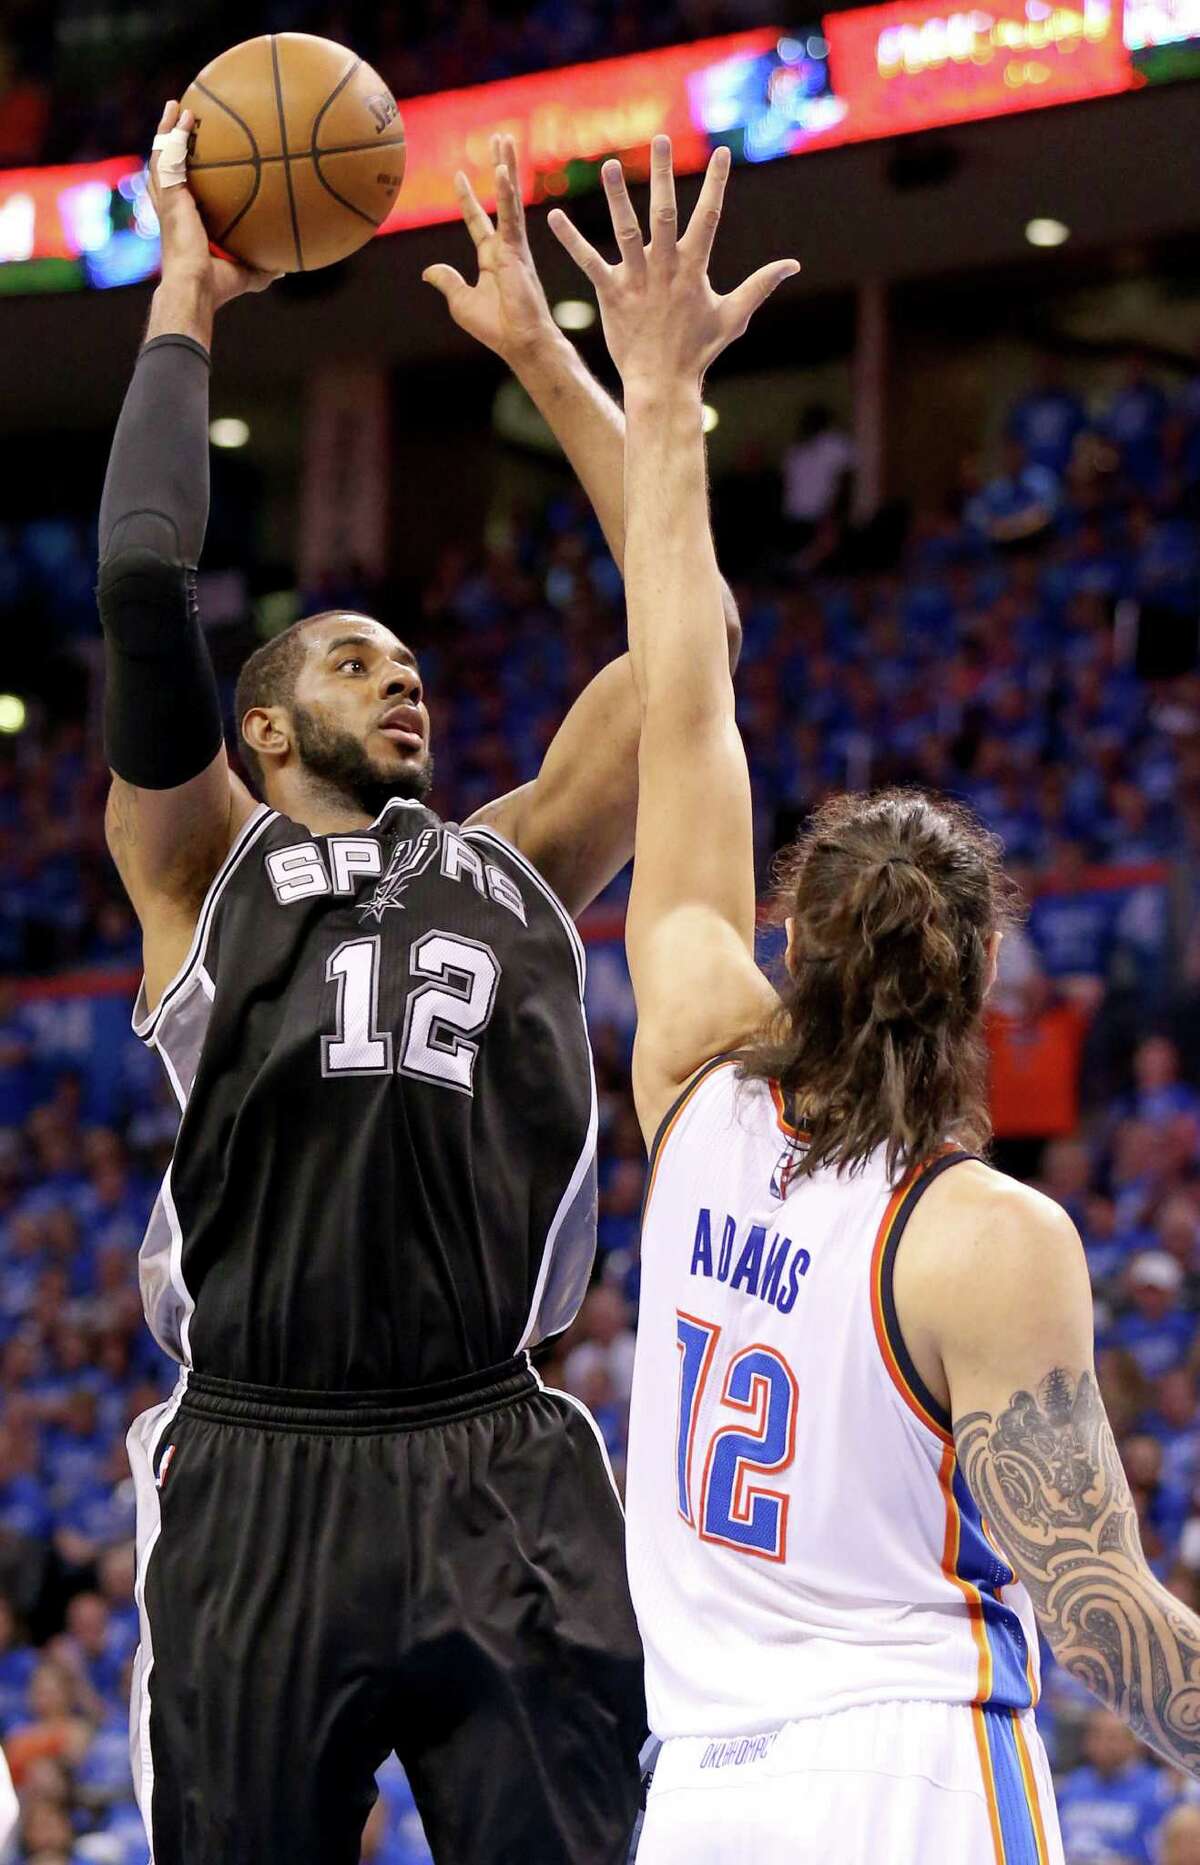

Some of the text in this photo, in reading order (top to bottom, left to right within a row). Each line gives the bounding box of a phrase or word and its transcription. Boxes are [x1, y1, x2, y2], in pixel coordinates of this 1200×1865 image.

[264, 829, 528, 928] SPURS
[320, 929, 502, 1097] 12
[690, 1208, 810, 1315] ADAMS
[676, 1310, 799, 1564] 12
